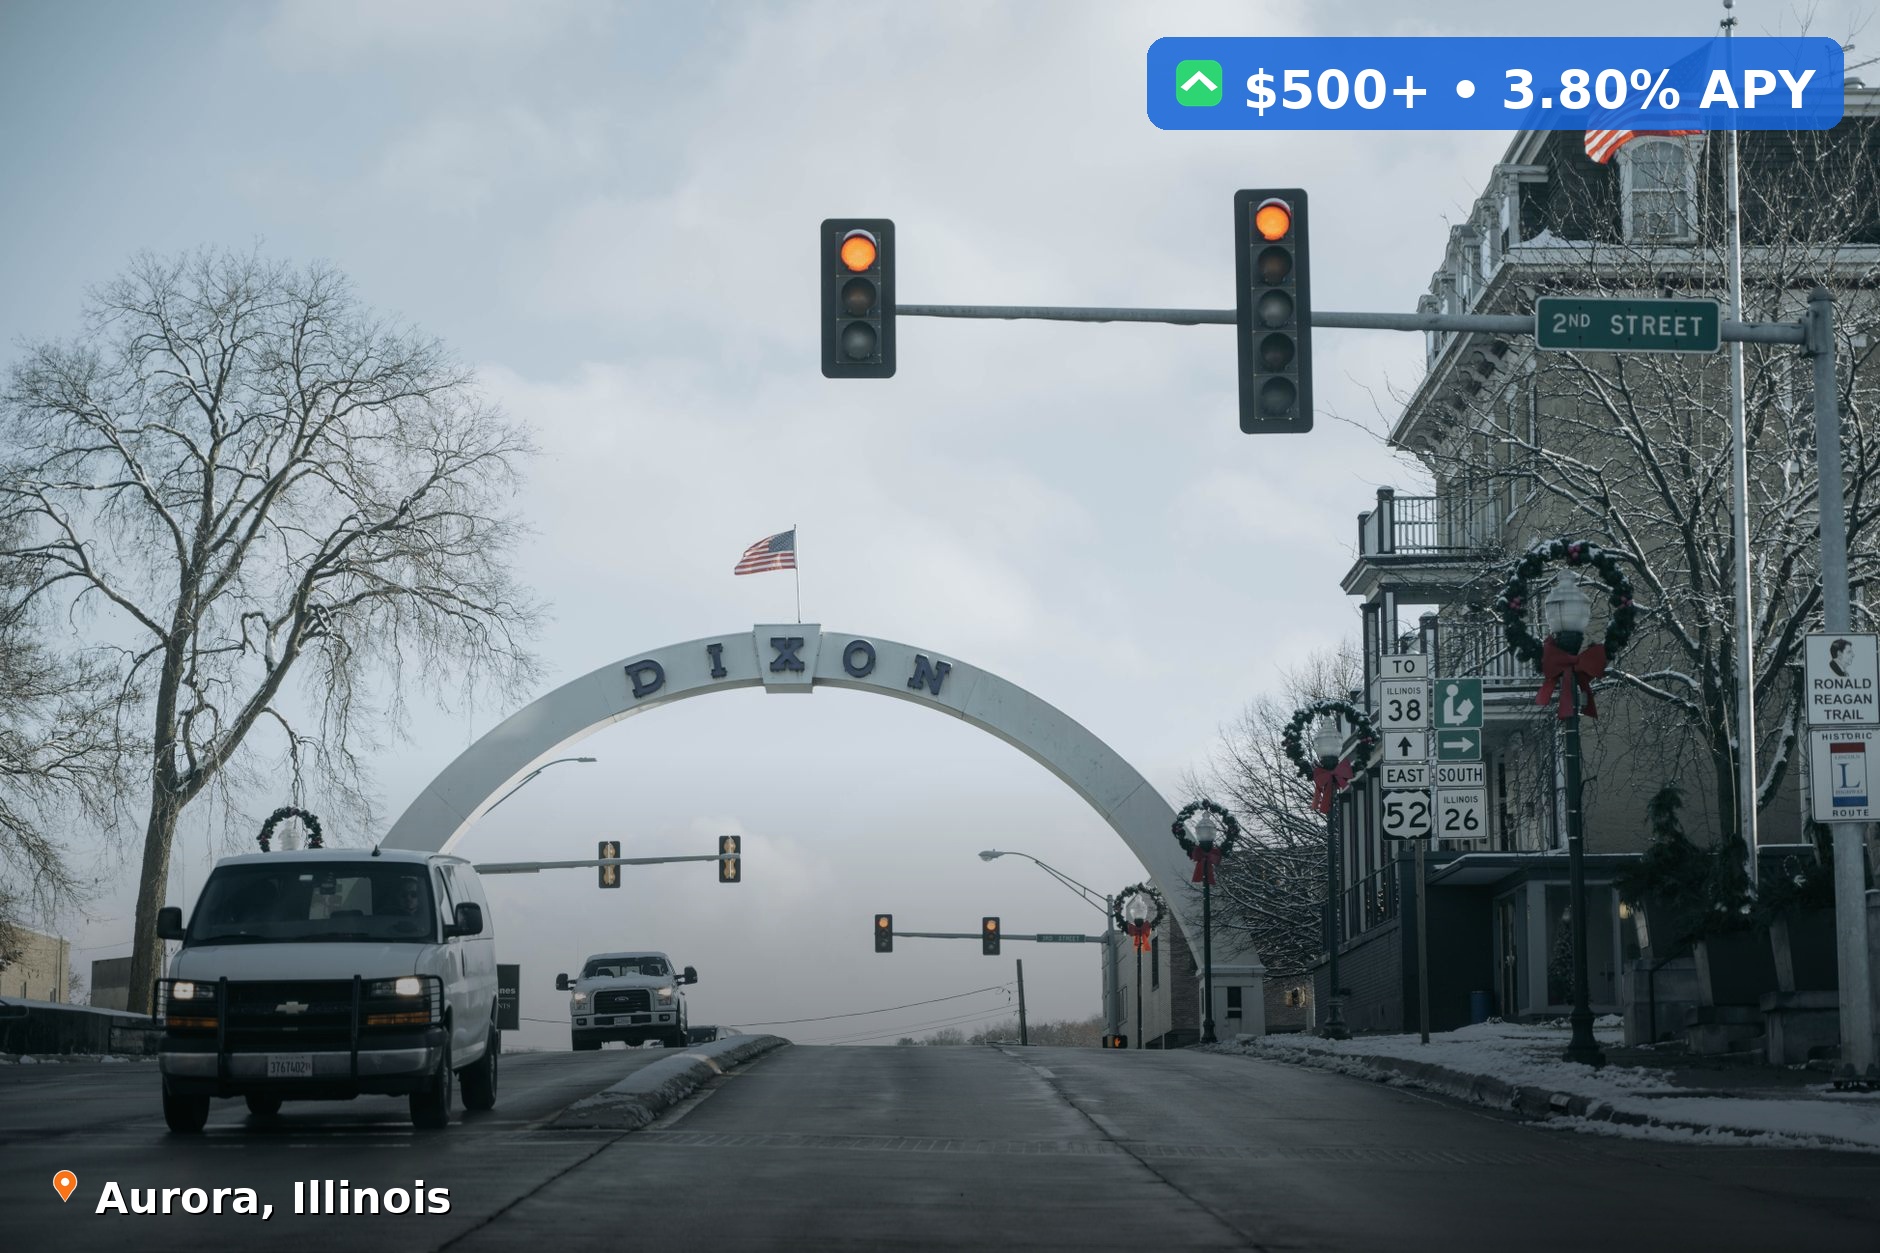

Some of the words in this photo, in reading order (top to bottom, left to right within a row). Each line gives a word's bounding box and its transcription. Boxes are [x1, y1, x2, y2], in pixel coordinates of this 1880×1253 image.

[1552, 313, 1591, 333] 2ND
[1610, 314, 1703, 337] STREET
[624, 636, 953, 699] DIXON
[1392, 659, 1416, 674] TO
[1386, 686, 1422, 695] ILLINOIS
[1814, 678, 1872, 690] RONALD
[1814, 693, 1873, 705] REAGAN
[1388, 698, 1421, 722] 38
[1824, 709, 1865, 720] TRAIL
[1821, 731, 1873, 741] HISTORIC
[1387, 768, 1425, 783] EAST
[1438, 767, 1483, 782] SOUTH
[1837, 762, 1861, 789] L
[1443, 795, 1479, 804] ILLINOIS
[1387, 801, 1428, 829] 52
[1445, 808, 1479, 831] 26
[1832, 808, 1870, 817] ROUTE
